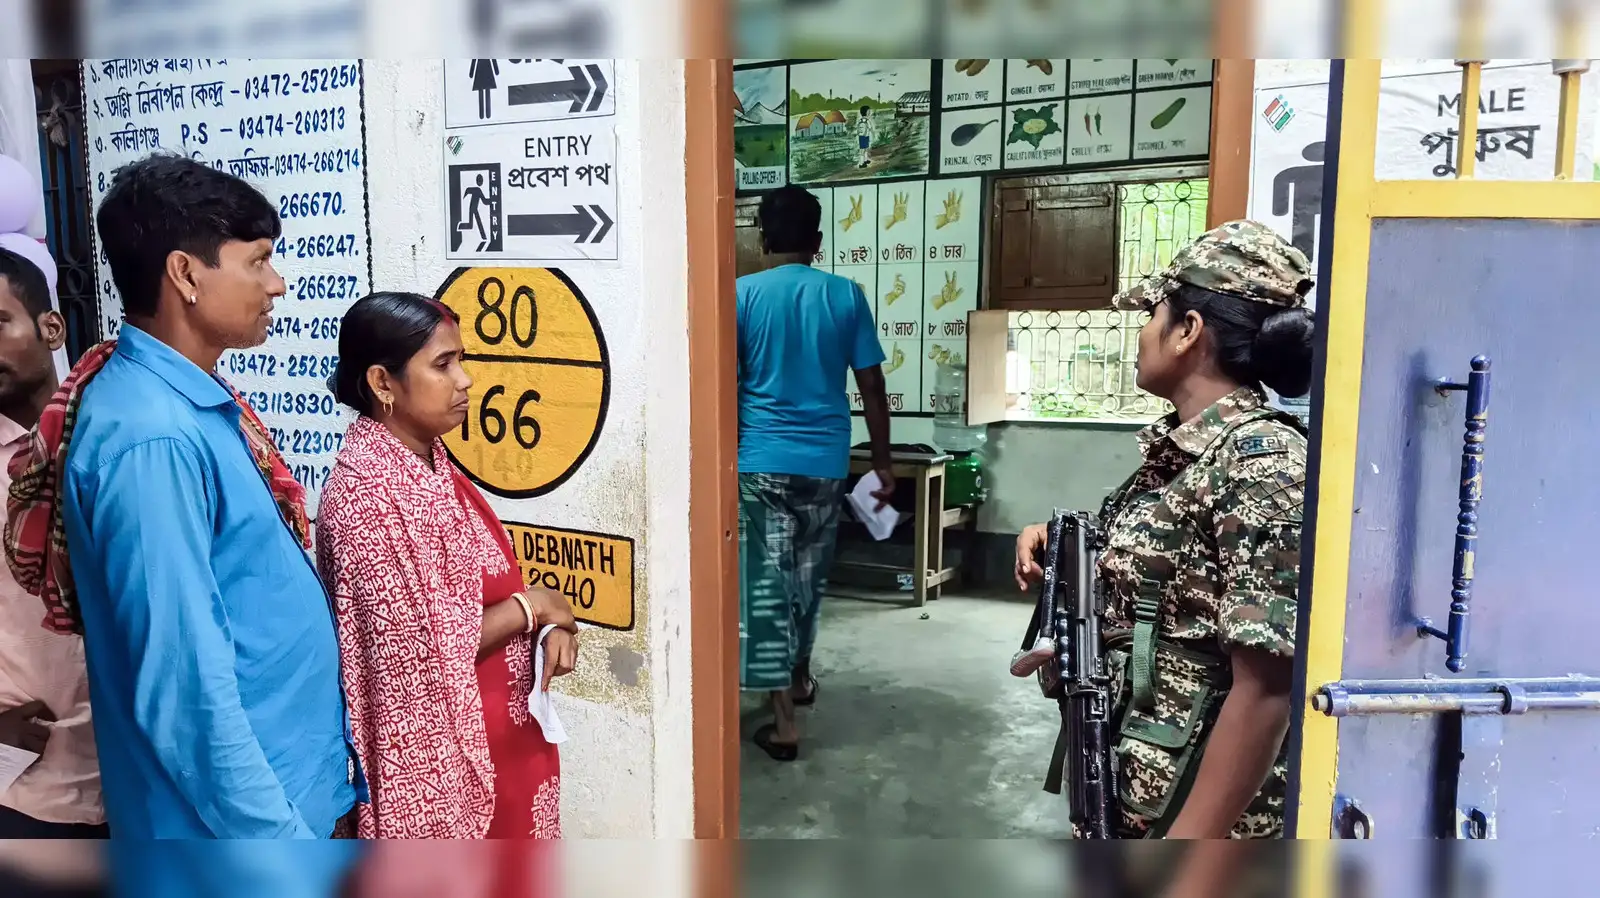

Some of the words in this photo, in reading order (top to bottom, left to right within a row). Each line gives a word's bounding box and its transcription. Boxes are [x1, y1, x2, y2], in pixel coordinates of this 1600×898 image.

[244, 64, 357, 100] 03472-252250
[1011, 86, 1032, 95] GINGER
[181, 122, 208, 147] P.S
[239, 106, 345, 140] 03474-260313
[525, 134, 592, 158] ENTRY
[508, 165, 570, 189] প্রবেশ
[575, 163, 612, 187] পথ
[279, 191, 346, 219] 266670.
[271, 233, 359, 259] 4-266247.
[475, 276, 538, 348] 80
[523, 531, 615, 577] DEBNATH
[519, 566, 596, 610] 2940
